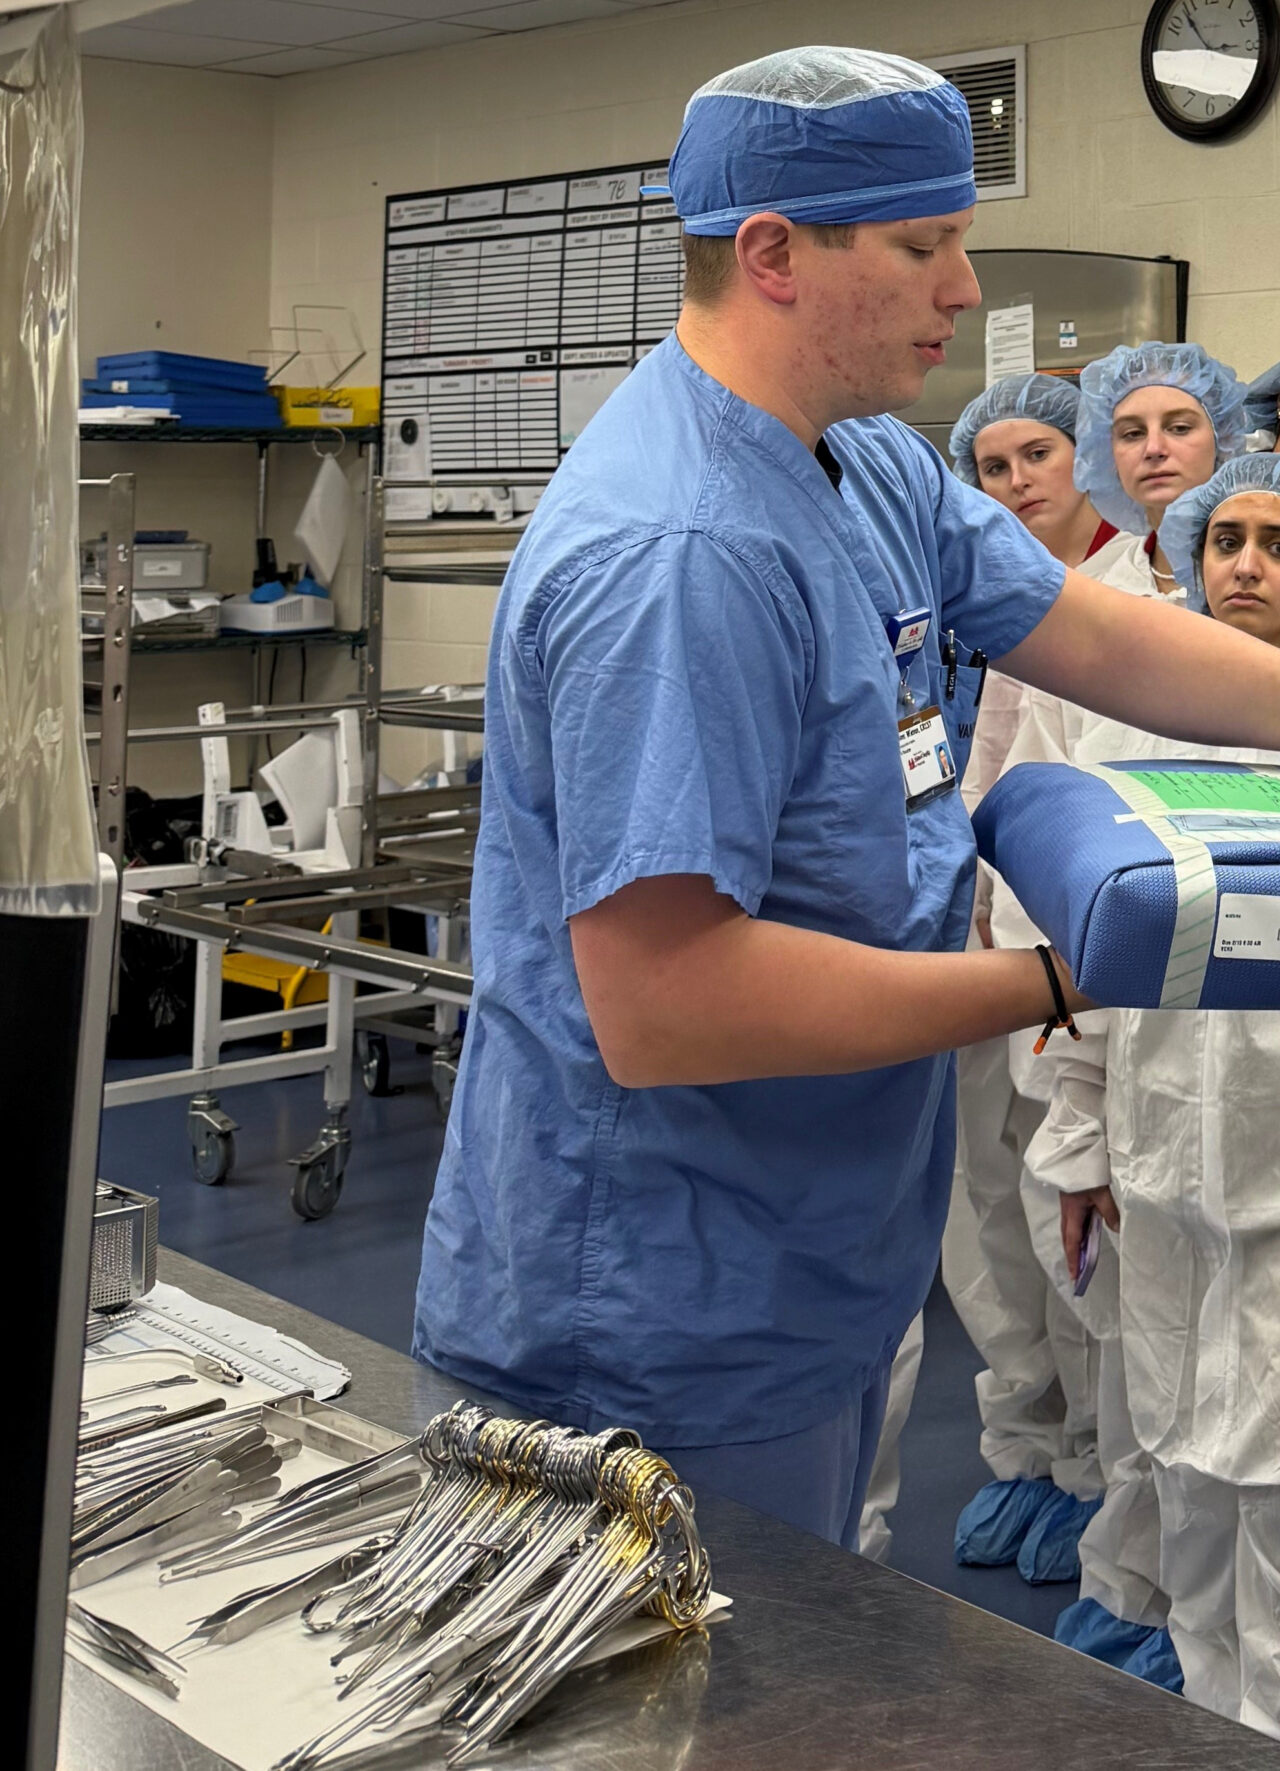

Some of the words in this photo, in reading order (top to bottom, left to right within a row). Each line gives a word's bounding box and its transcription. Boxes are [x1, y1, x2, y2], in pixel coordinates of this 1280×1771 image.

[1168, 15, 1183, 36] 10
[1183, 90, 1196, 108] 7
[1205, 96, 1215, 116] 6
[607, 180, 626, 201] 78
